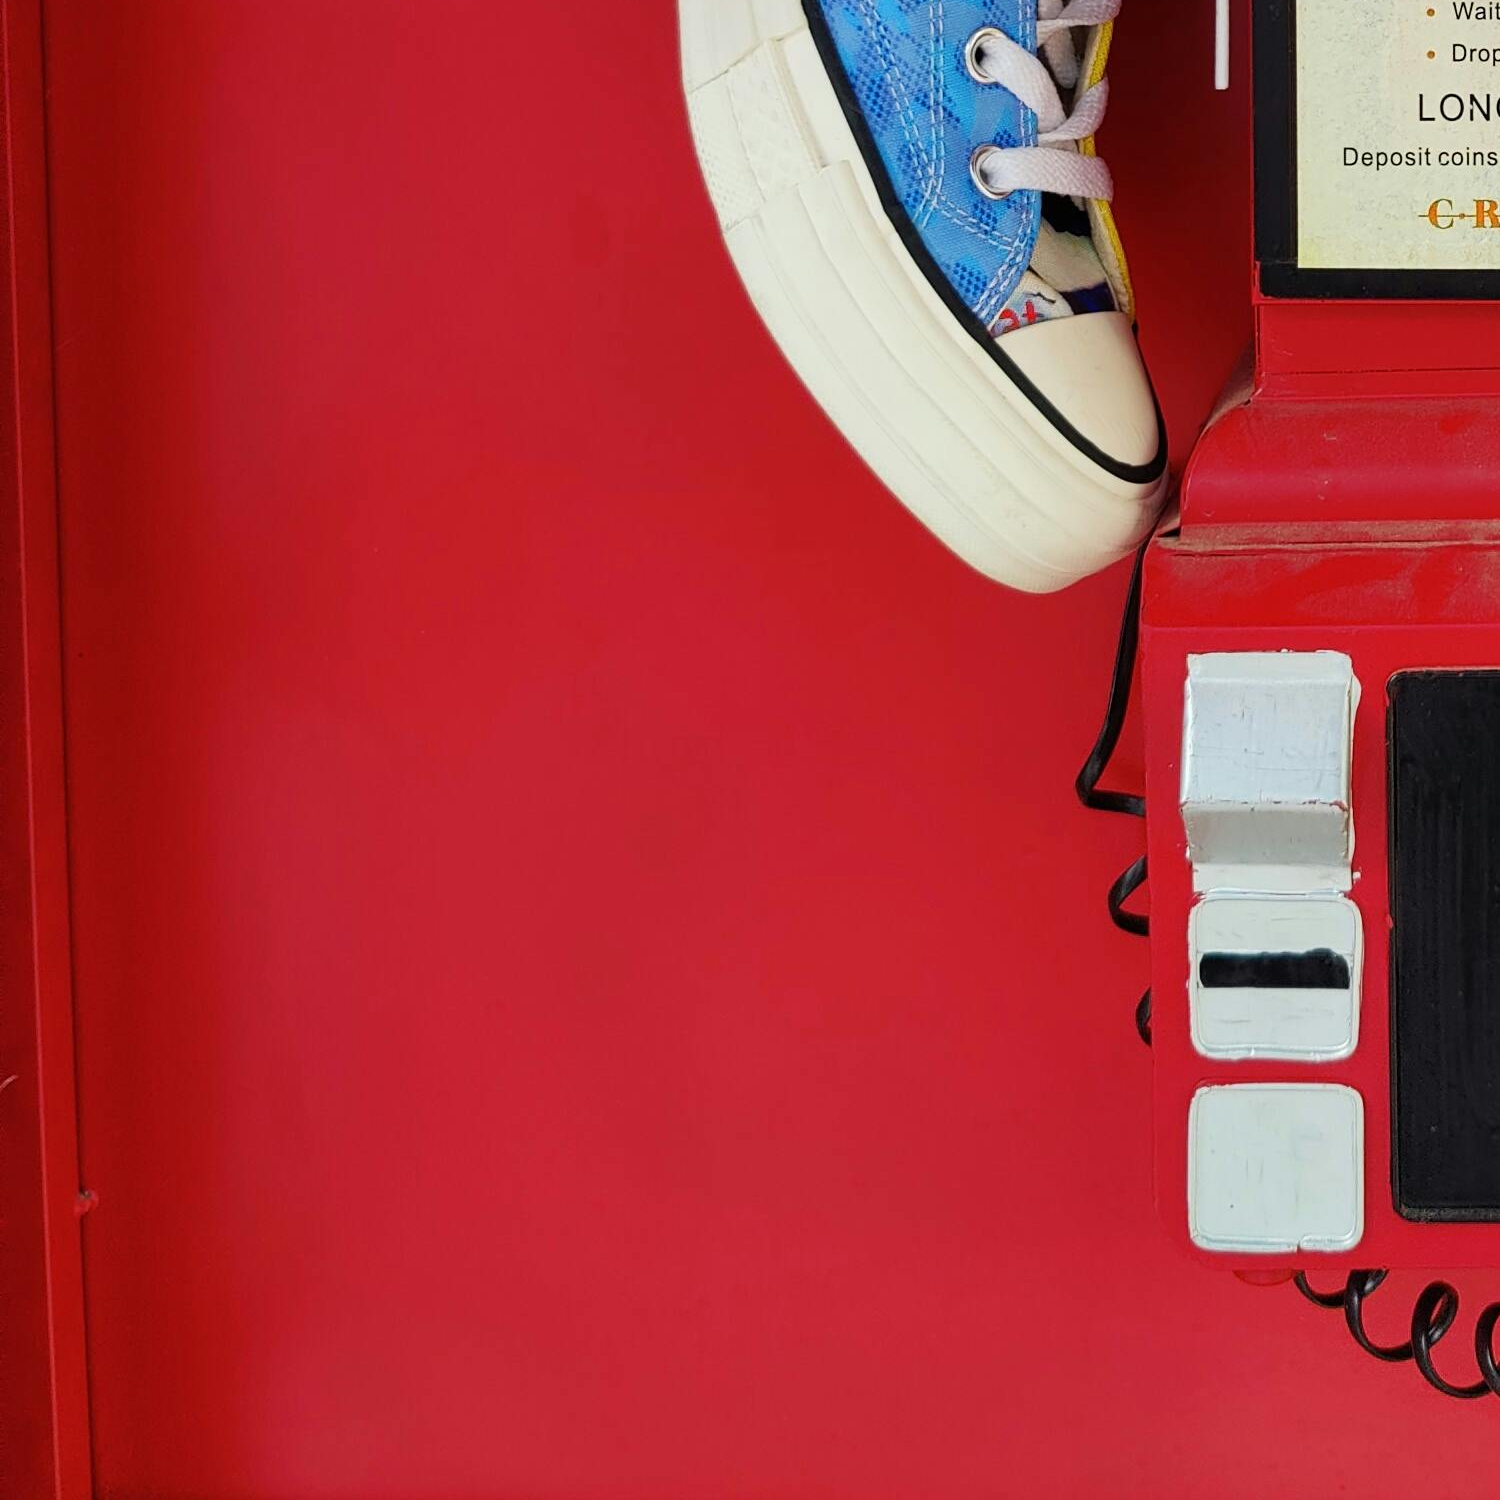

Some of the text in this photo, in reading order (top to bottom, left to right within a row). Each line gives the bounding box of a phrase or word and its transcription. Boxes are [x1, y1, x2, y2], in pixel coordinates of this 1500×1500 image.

[1453, 2, 1500, 20] Wait
[1344, 148, 1431, 170] Deposit
[1439, 152, 1497, 166] coins
